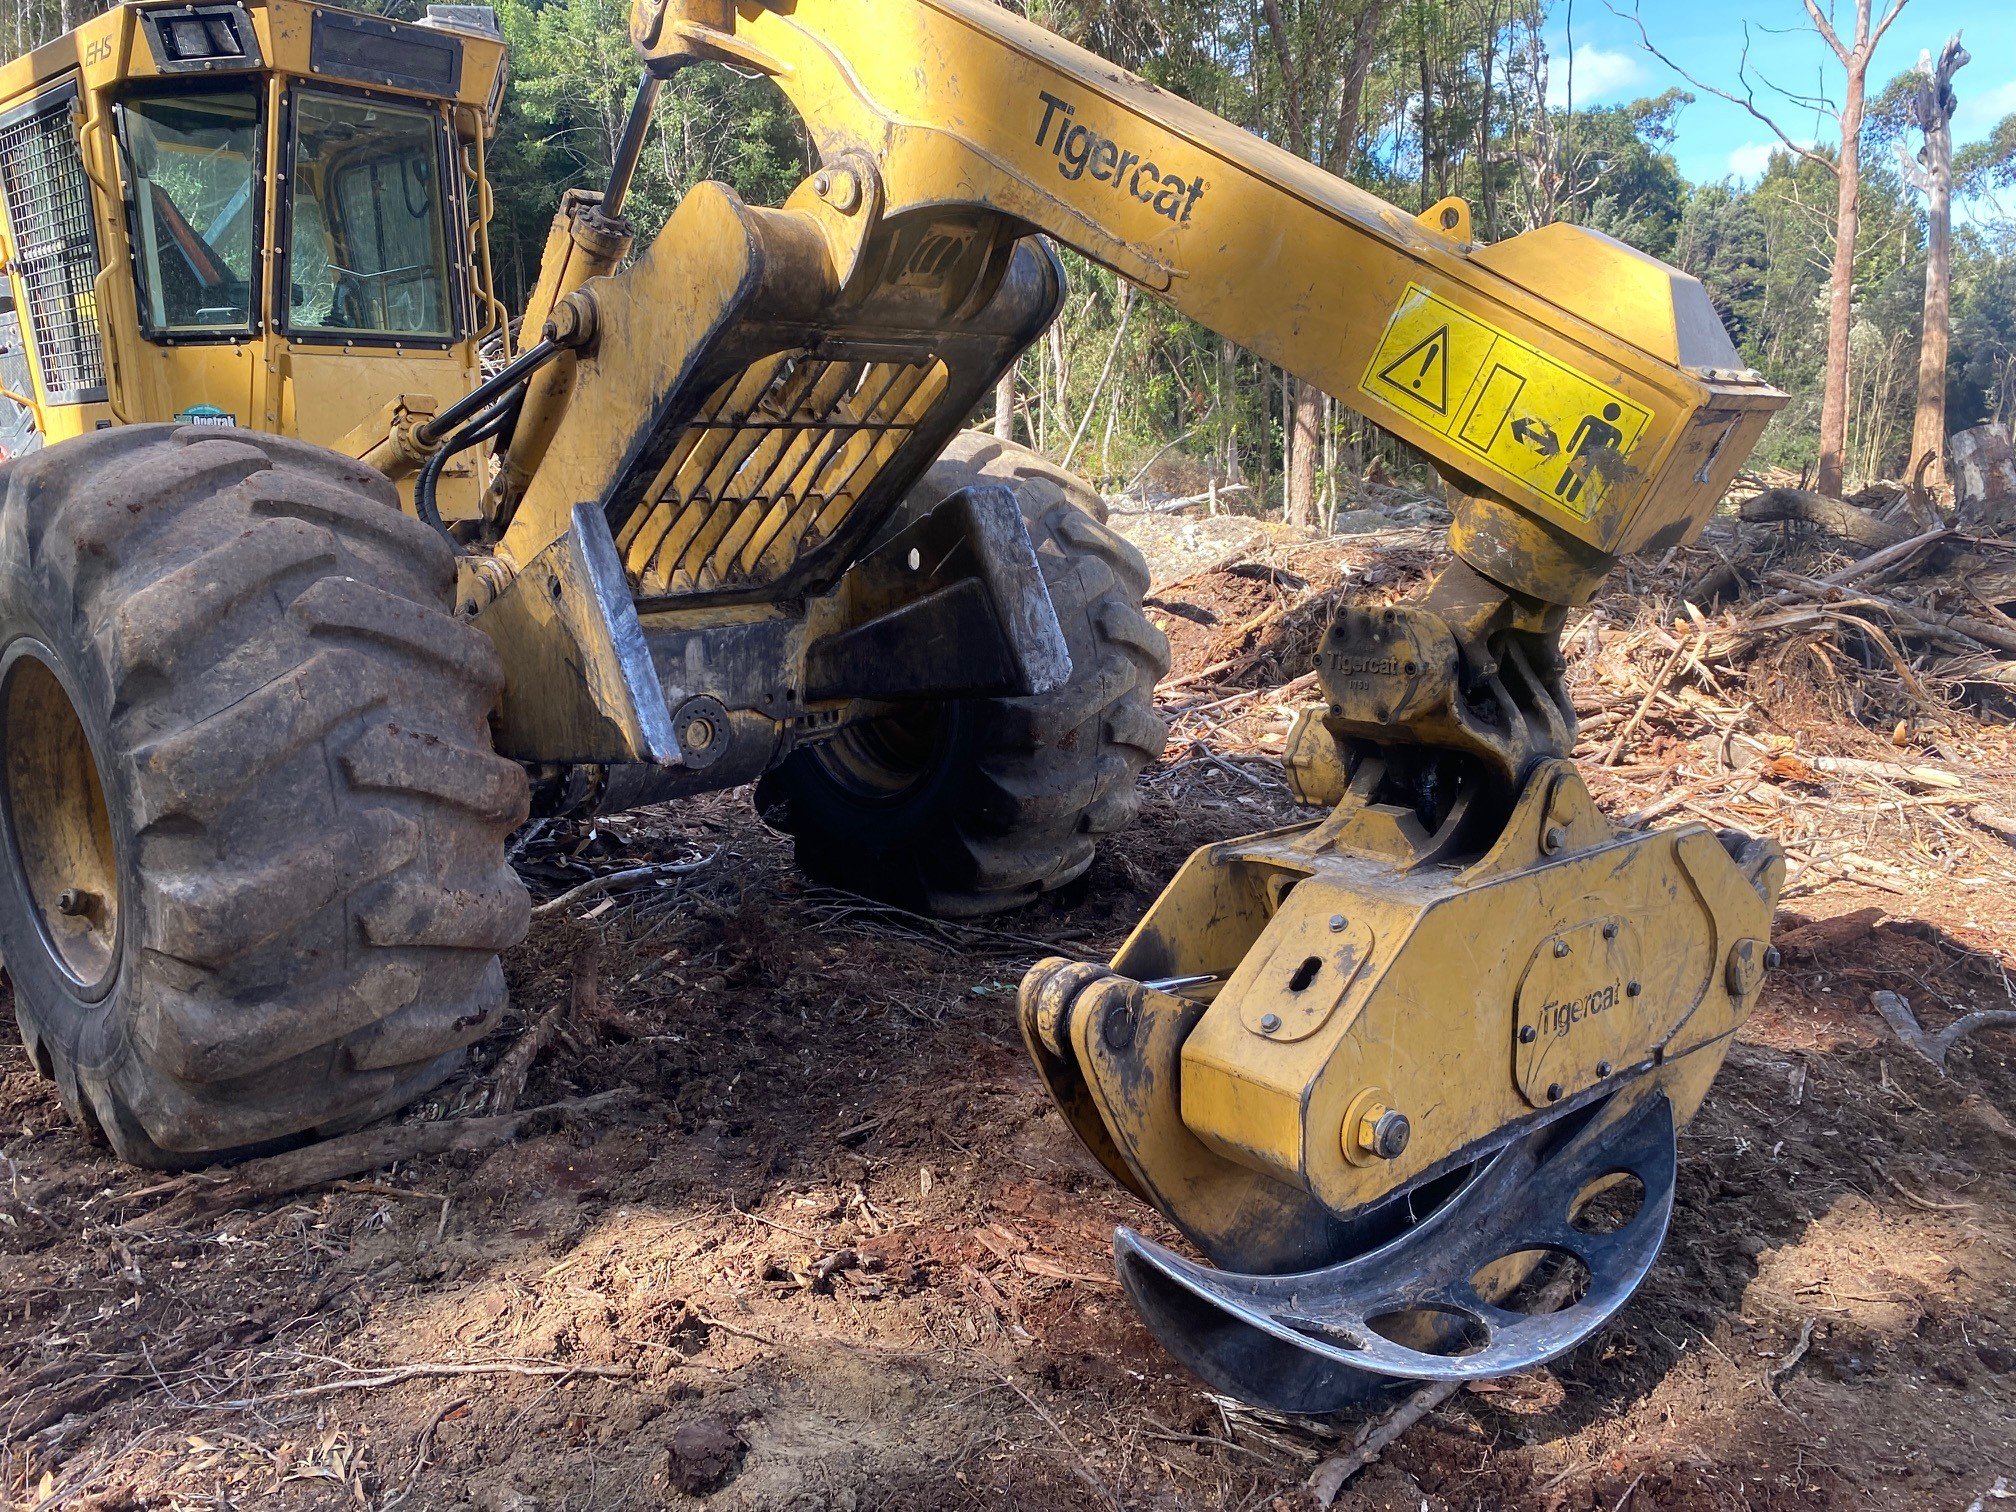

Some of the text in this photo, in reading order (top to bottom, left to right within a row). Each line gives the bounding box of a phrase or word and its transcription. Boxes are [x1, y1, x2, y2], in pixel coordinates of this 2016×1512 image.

[85, 33, 113, 67] EHS
[1034, 89, 1205, 224] Tigercat
[192, 415, 235, 428] Onetrak
[1327, 649, 1398, 676] Tigercat
[1540, 976, 1620, 1038] Tigercat
